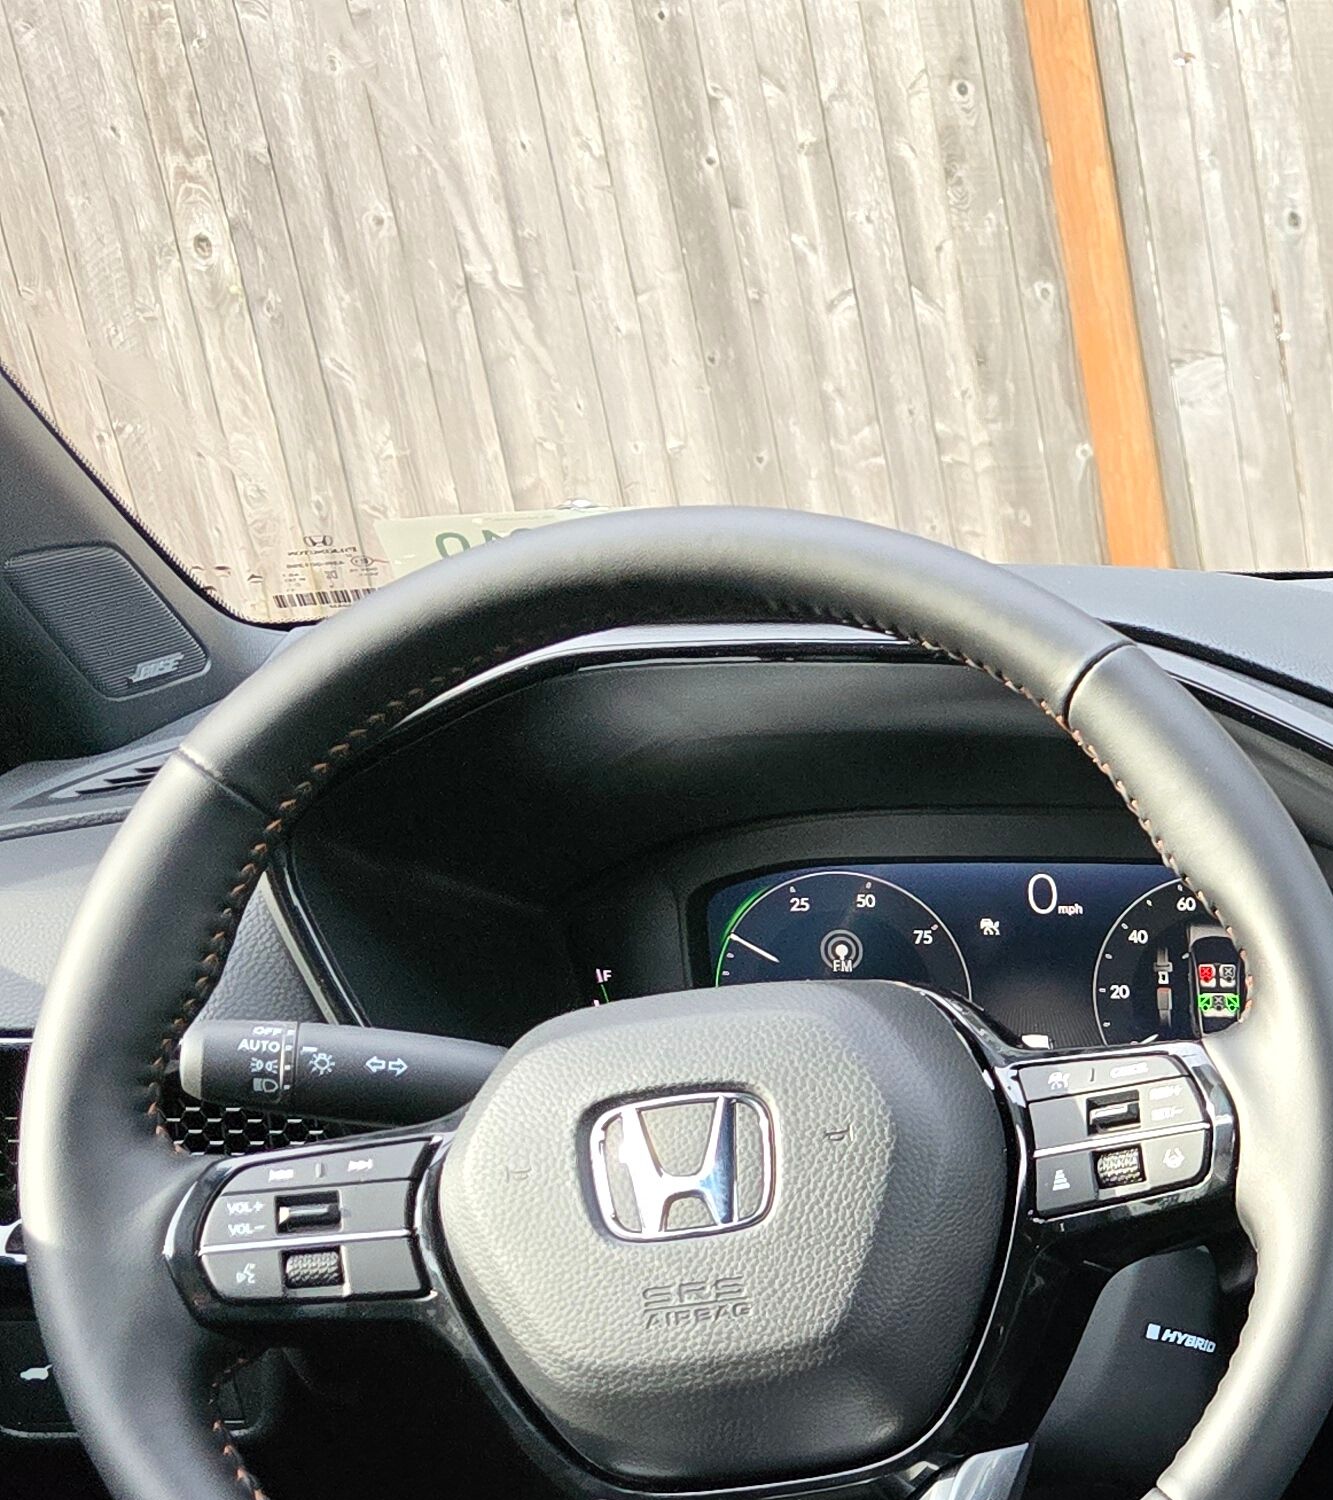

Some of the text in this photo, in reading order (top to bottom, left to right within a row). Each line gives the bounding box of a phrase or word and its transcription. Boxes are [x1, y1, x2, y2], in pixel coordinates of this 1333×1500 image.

[855, 893, 876, 908] 50
[1027, 873, 1058, 915] 0
[789, 897, 811, 912] 25
[1057, 903, 1083, 916] mph
[1176, 896, 1197, 912] 60
[912, 929, 934, 945] 75
[1127, 929, 1149, 944] 40
[832, 959, 853, 973] FM
[602, 969, 612, 982] F
[1109, 984, 1130, 999] 20
[252, 1026, 283, 1036] OFF
[237, 1038, 281, 1051] AUTO
[1161, 1329, 1217, 1354] HYBRID
